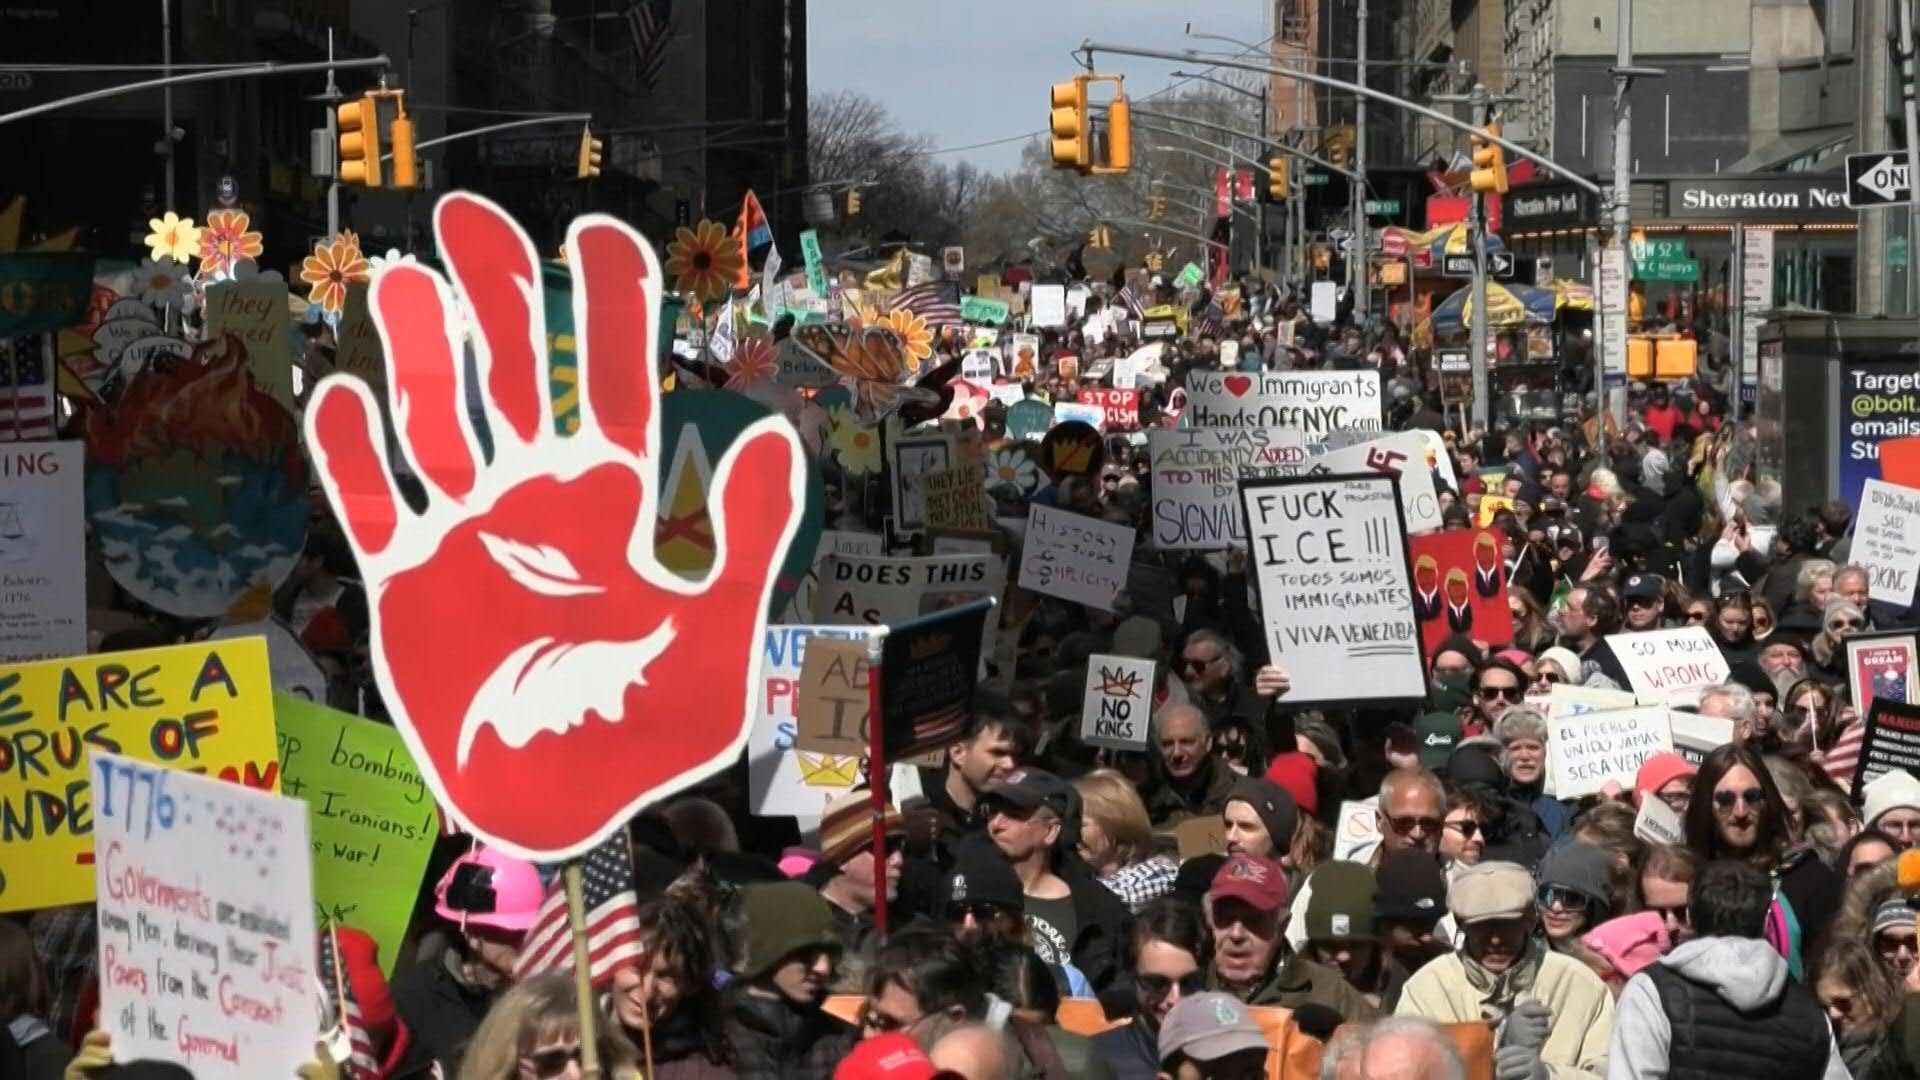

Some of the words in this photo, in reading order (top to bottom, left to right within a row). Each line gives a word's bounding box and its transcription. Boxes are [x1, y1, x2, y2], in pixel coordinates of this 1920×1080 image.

[1683, 188, 1799, 209] Sheraton
[1658, 242, 1673, 257] 52
[1188, 371, 1222, 396] We
[1257, 372, 1377, 402] Immigrants
[1850, 370, 1920, 394] Target
[1083, 390, 1133, 405] STOP
[1176, 429, 1203, 447] I
[1215, 429, 1271, 448] WAS
[1255, 446, 1304, 464] ADDED
[1160, 469, 1193, 485] TO
[1194, 465, 1235, 485] THIS
[1256, 488, 1343, 525] FUCK
[1154, 499, 1249, 546] SIGNAL
[834, 561, 912, 585] DOES
[925, 561, 987, 584] THIS
[1278, 574, 1334, 587] TODOS
[1340, 568, 1397, 586] SOMOS
[1284, 588, 1413, 611] IMMIGRANTES
[1631, 641, 1656, 655] SO
[1666, 639, 1714, 652] MUCH
[1643, 662, 1718, 688] WRONG
[57, 663, 165, 723] ARE
[189, 651, 238, 702] A
[1101, 697, 1131, 720] NO
[150, 708, 220, 760] OF
[1095, 717, 1133, 738] KINGS
[1560, 728, 1577, 741] EL
[1584, 719, 1638, 737] PUEBLO
[330, 726, 426, 804] bombing
[316, 791, 432, 841] Iranians!
[333, 843, 381, 867] War!
